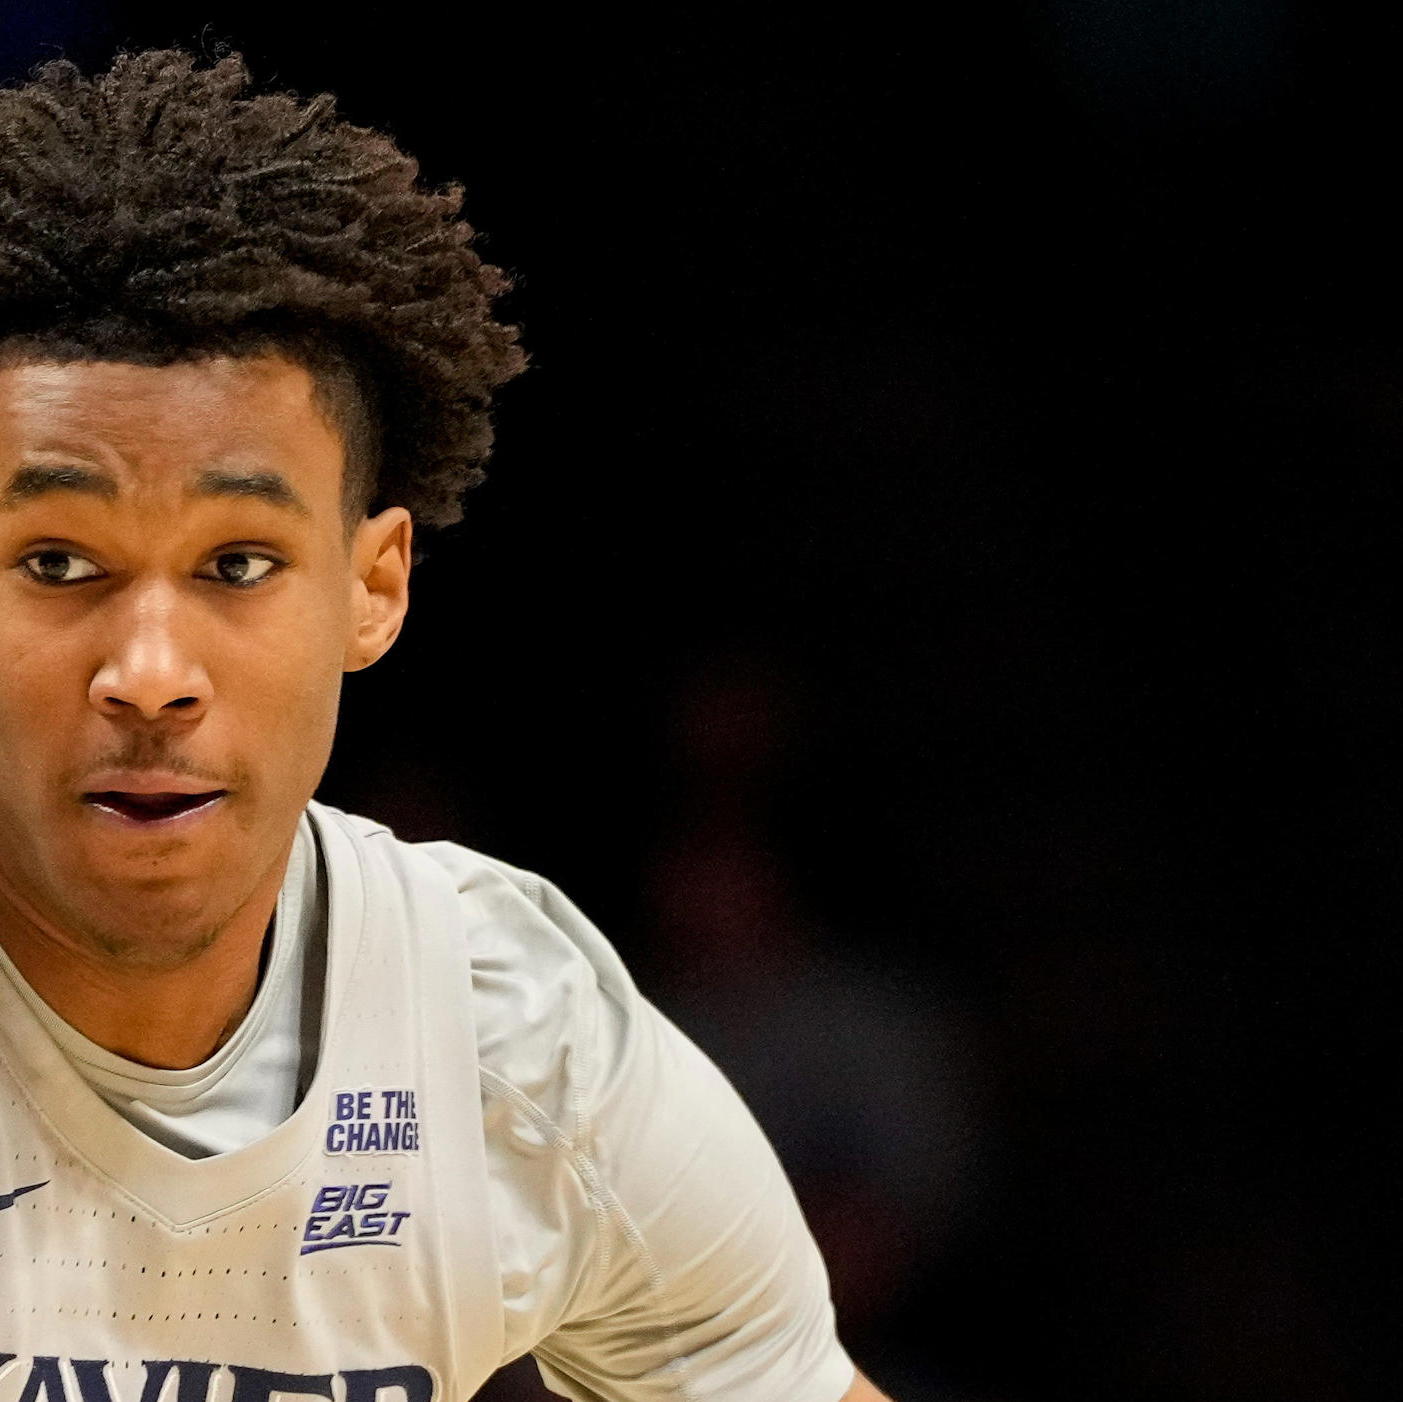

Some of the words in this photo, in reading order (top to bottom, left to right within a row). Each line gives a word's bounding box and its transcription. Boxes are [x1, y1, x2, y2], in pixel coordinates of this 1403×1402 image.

[336, 1091, 372, 1121] BE
[311, 1181, 392, 1213] BIG
[303, 1211, 410, 1241] EAST
